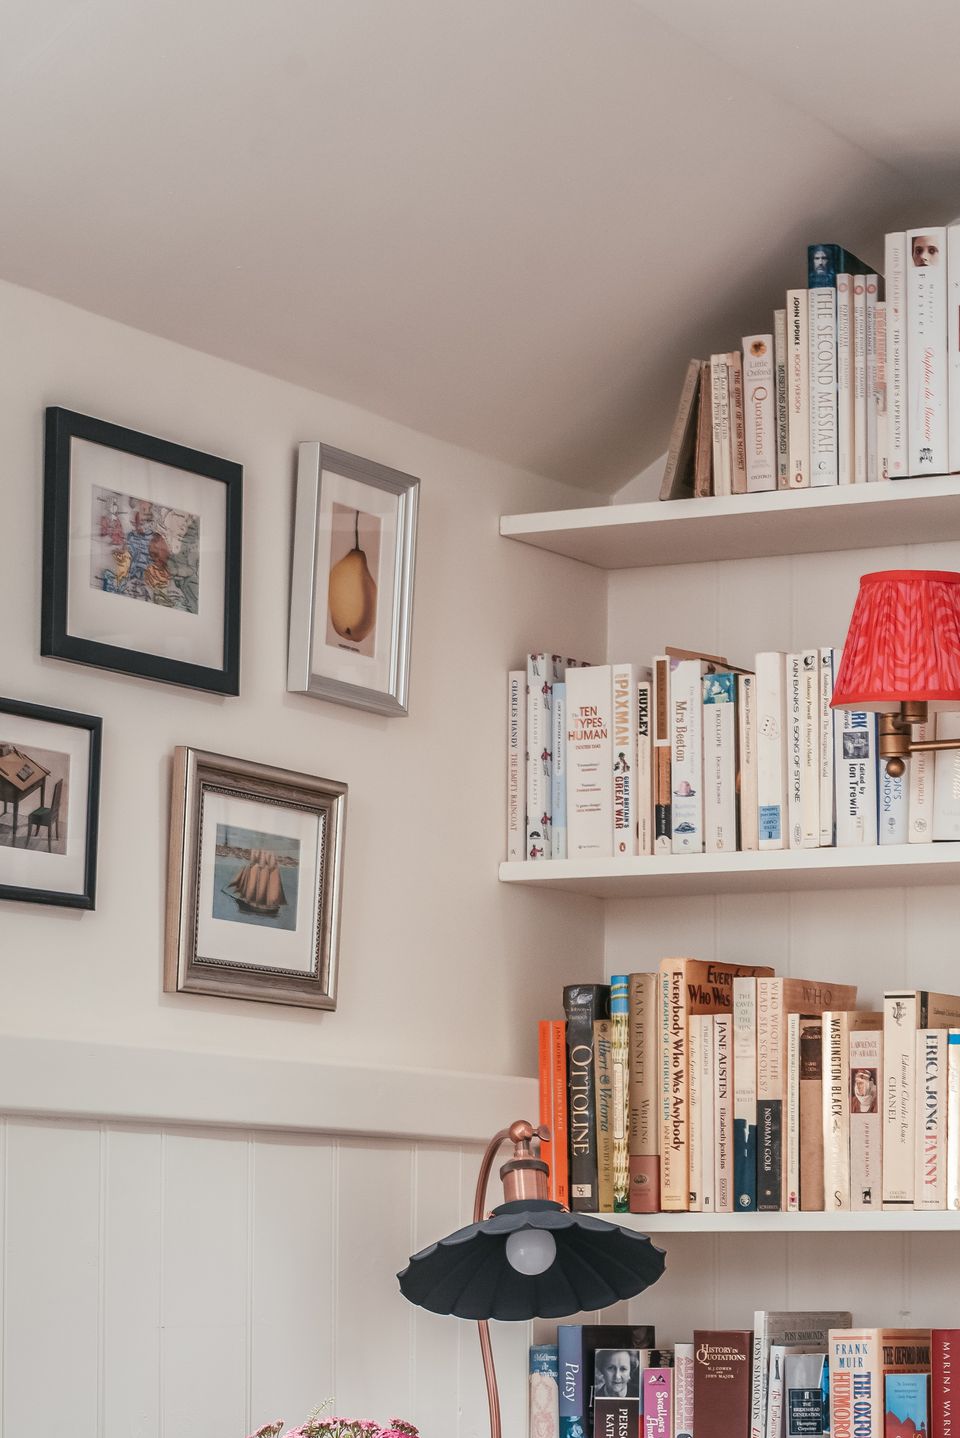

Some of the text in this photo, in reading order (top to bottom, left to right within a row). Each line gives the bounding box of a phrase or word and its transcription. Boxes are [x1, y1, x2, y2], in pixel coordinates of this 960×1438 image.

[817, 290, 833, 454] THE SECOND MESSIAH
[751, 386, 768, 455] Quotations
[569, 731, 607, 740] HUMAN
[575, 718, 602, 727] TYPES
[580, 706, 597, 717] TEN
[616, 681, 628, 746] PAXMAN
[639, 689, 648, 736] HUXLEY
[676, 701, 687, 762] Mrs Beeton
[614, 776, 623, 829] GREAT WAR
[849, 780, 859, 816] Trewin
[830, 1018, 842, 1117] WASHINGTON BLACK
[572, 1046, 592, 1156] OTTOLINE
[924, 1035, 937, 1187] ERICA JONG FANNY
[764, 1149, 772, 1171] GOLB
[564, 1362, 578, 1401] Patsy
[854, 1372, 872, 1398] THE
[943, 1342, 951, 1393] MARINA
[656, 1392, 667, 1433] Swallows
